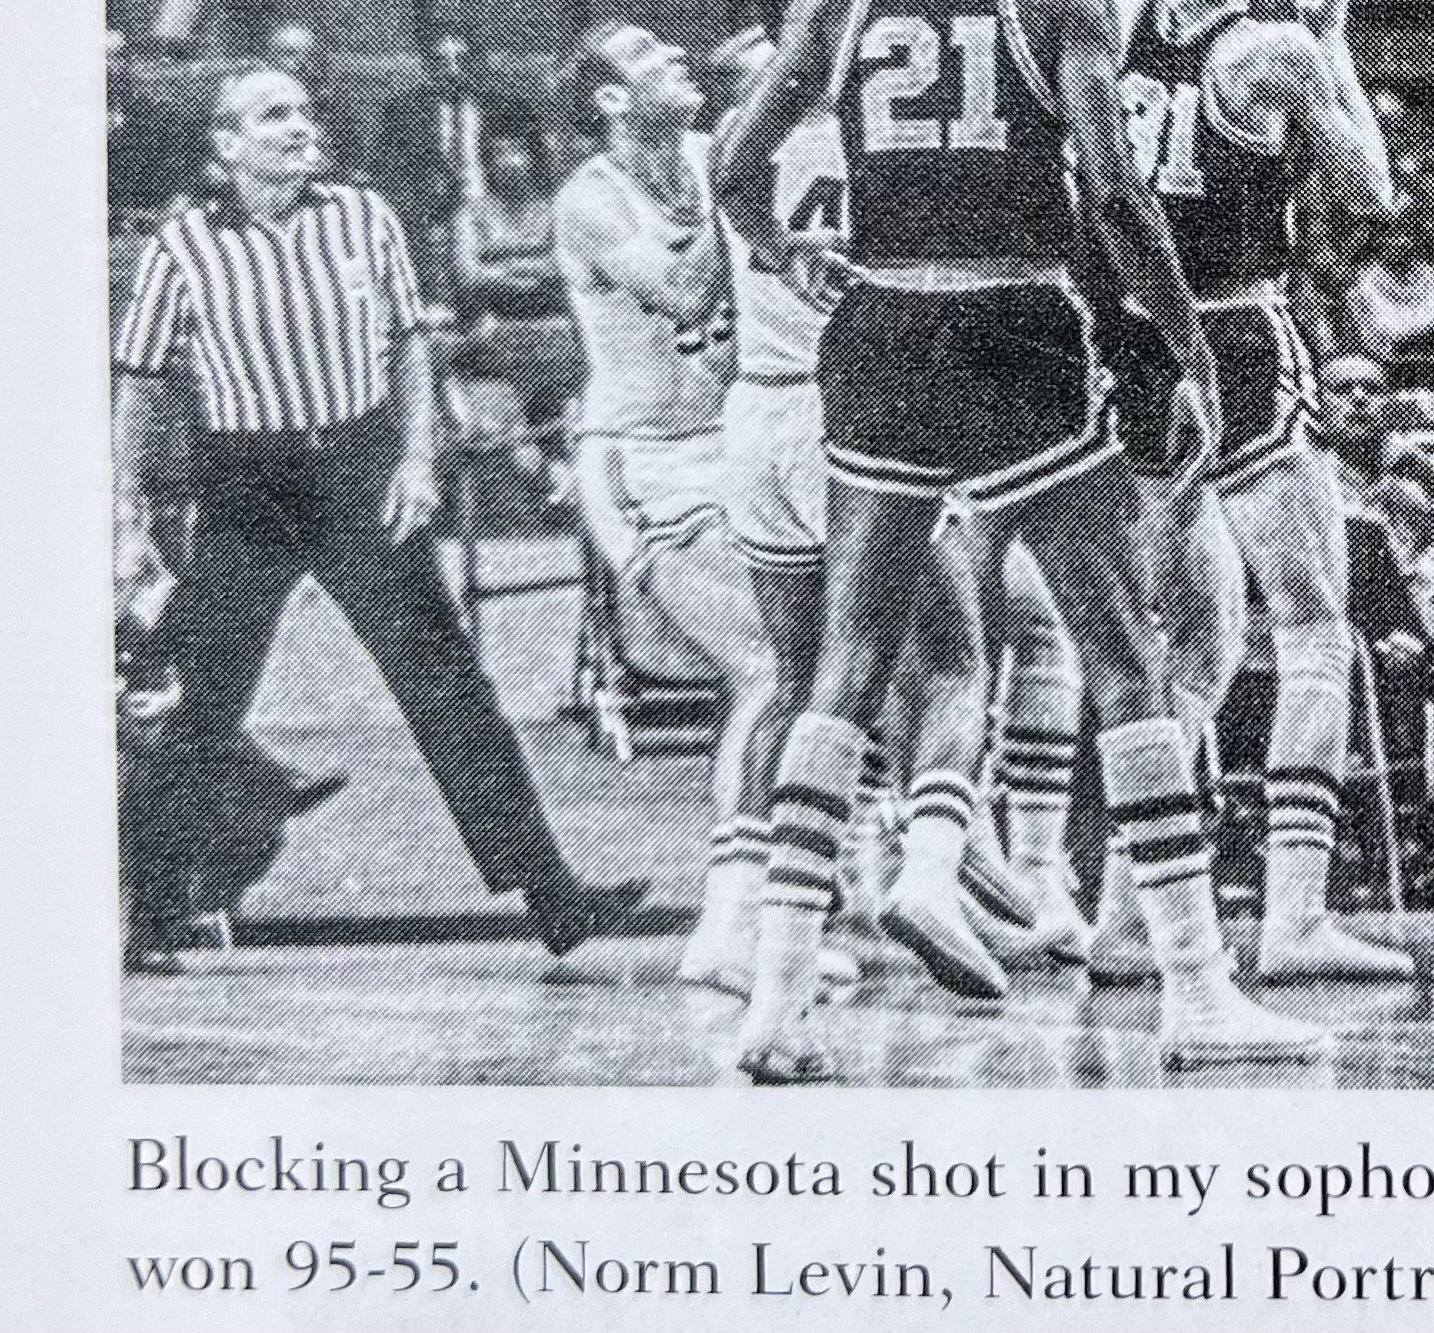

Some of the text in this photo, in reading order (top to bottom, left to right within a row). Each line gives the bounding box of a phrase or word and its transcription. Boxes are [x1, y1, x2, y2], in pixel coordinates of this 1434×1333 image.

[859, 14, 1008, 153] 21
[126, 1132, 414, 1212] Blocking
[435, 1156, 472, 1195] a
[496, 1137, 847, 1199] Minnesota
[870, 1137, 1009, 1201] shot
[1031, 1144, 1098, 1201] in
[1122, 1161, 1223, 1219] my
[124, 1254, 259, 1294] won
[283, 1237, 482, 1295] 95-55.
[511, 1233, 725, 1306] (Norm
[749, 1240, 955, 1313] Levin,
[982, 1240, 1240, 1303] Natural
